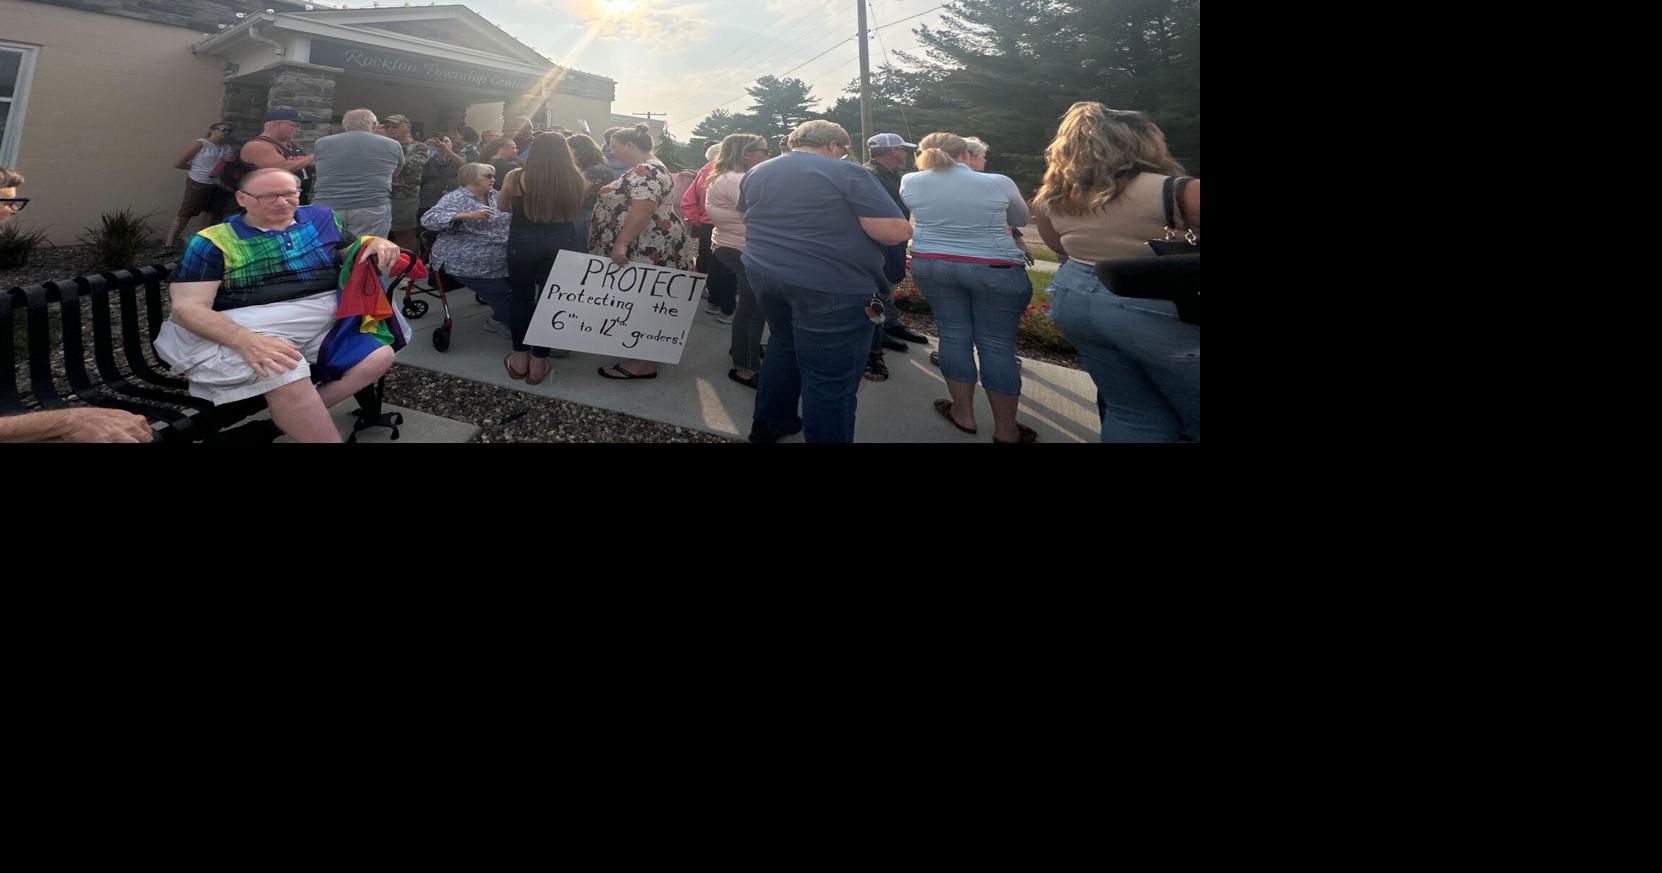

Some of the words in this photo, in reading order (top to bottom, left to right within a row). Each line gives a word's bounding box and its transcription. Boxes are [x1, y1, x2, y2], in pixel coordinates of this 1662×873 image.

[344, 49, 417, 73] Rockton
[424, 62, 489, 86] Township
[580, 258, 706, 302] PROTECT
[547, 284, 634, 322] Protecting
[652, 301, 679, 317] the
[580, 321, 592, 332] to
[622, 330, 686, 348] graders!
